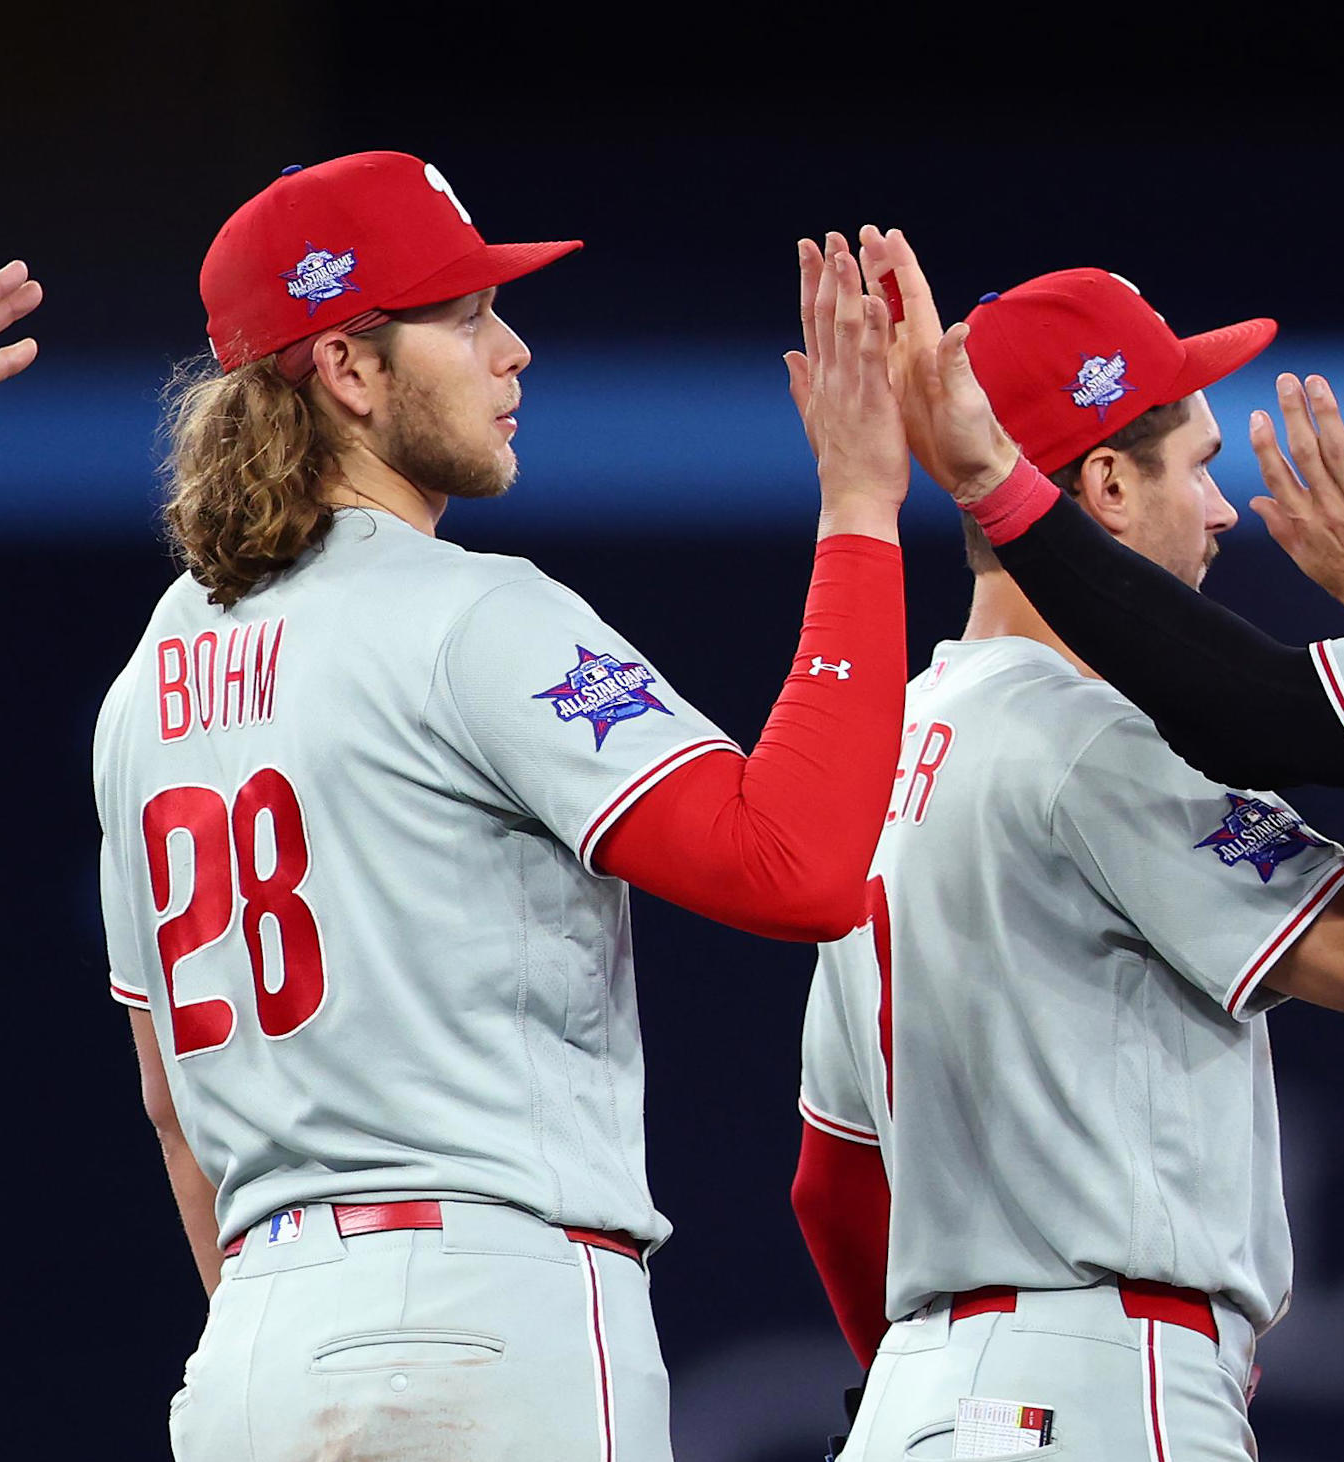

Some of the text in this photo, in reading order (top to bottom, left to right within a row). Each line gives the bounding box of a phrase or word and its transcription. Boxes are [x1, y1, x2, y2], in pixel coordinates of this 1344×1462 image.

[156, 617, 286, 744] BOHM
[557, 665, 652, 718] ALL STAR GAME
[1219, 838, 1250, 862] ALL
[1241, 818, 1276, 848] STAR
[141, 764, 329, 1060] 28
